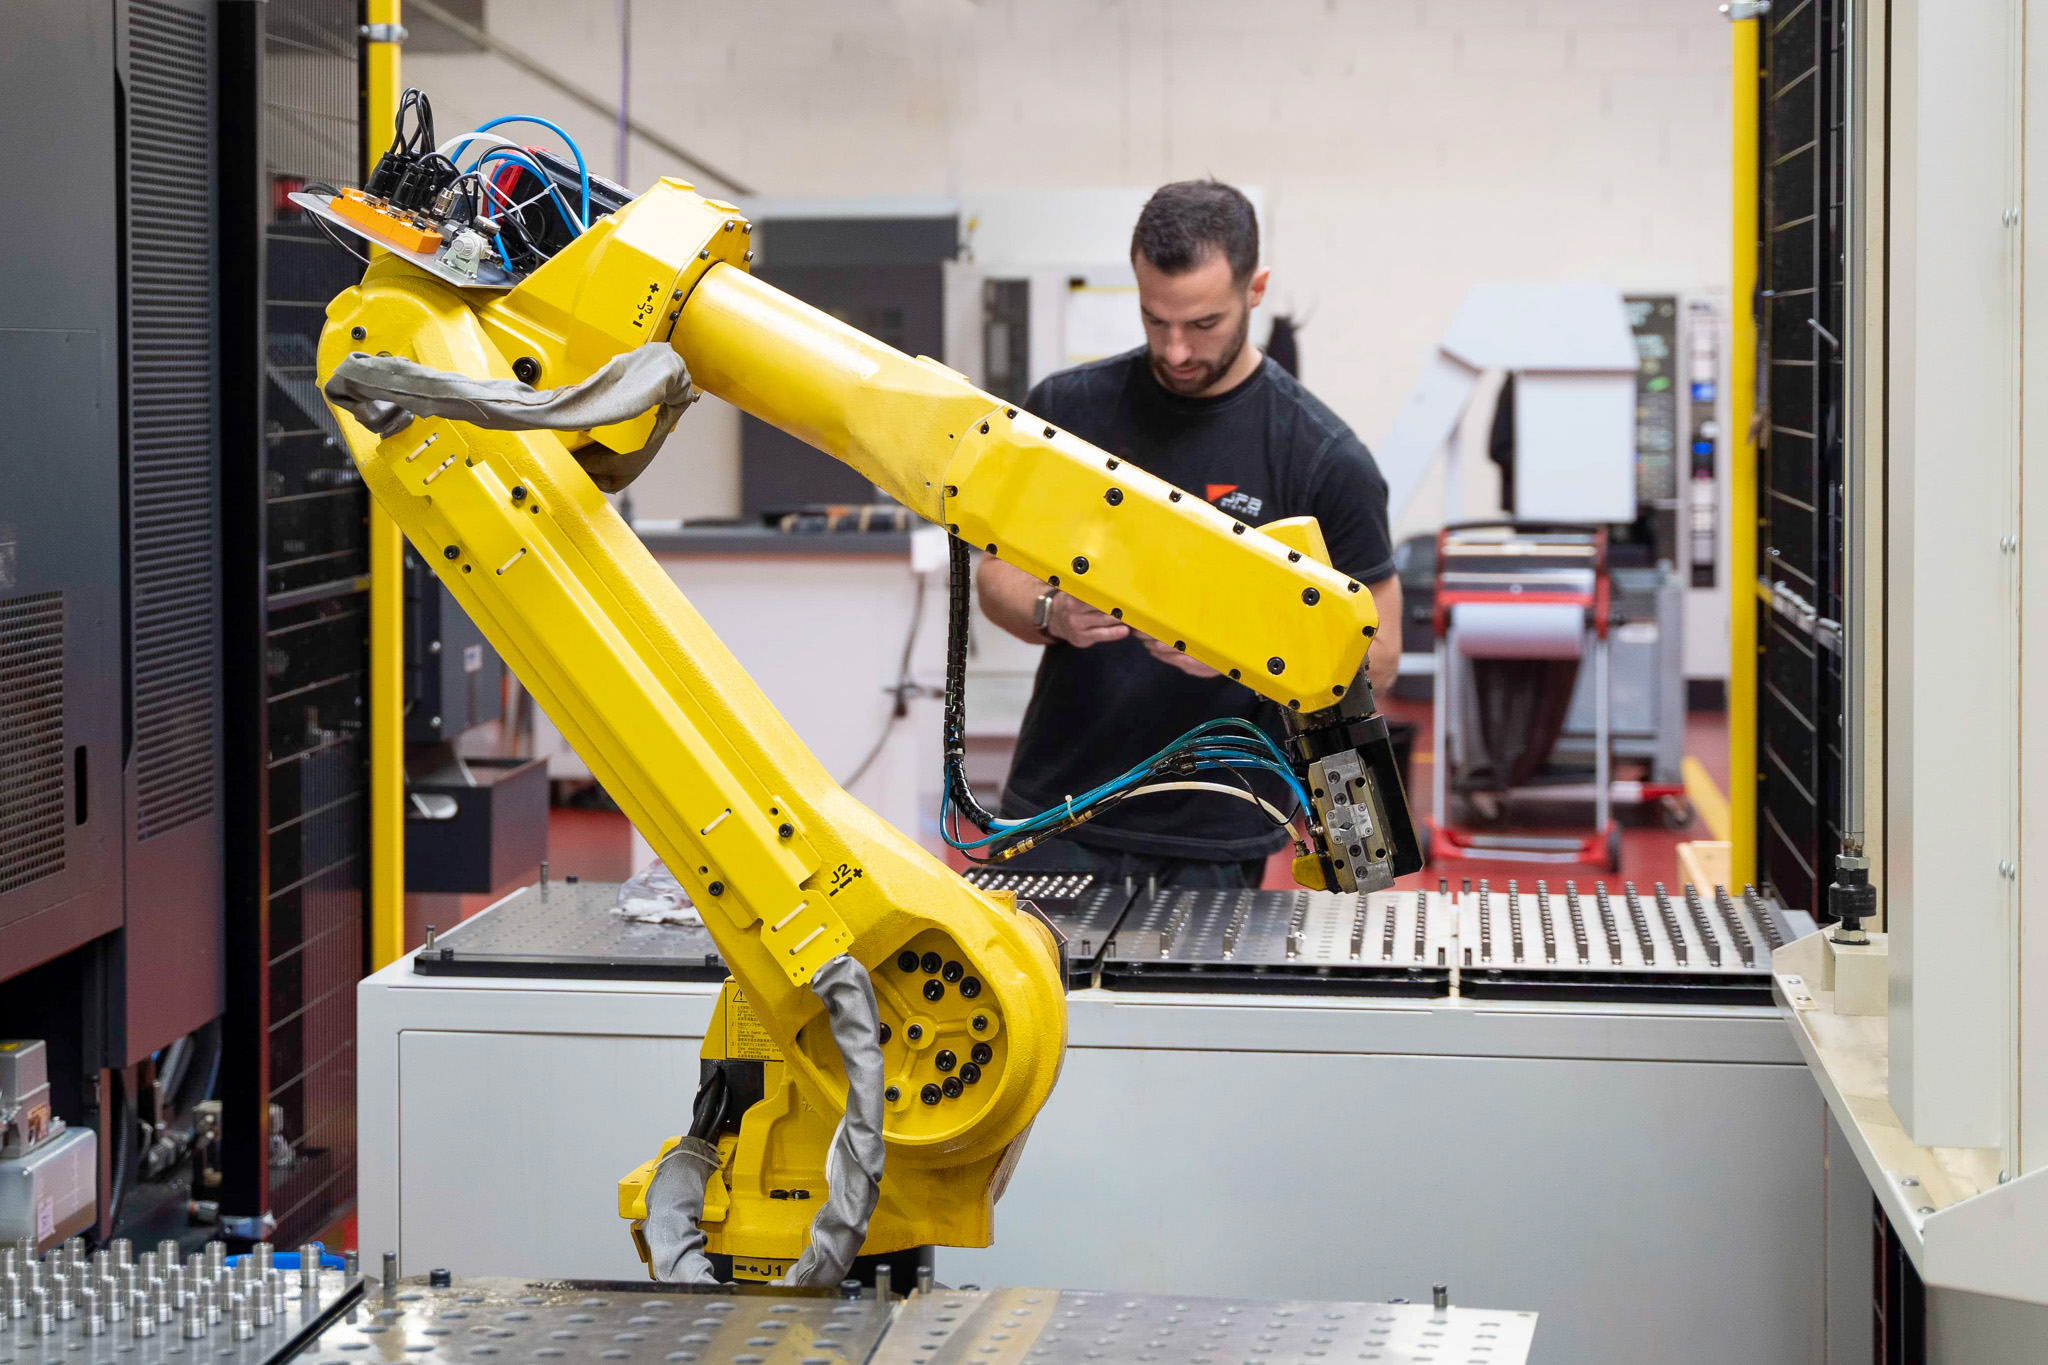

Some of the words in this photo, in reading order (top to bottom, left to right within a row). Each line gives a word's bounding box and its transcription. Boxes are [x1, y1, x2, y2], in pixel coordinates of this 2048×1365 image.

[637, 302, 654, 314] J3
[830, 863, 851, 884] J2
[760, 1264, 782, 1276] J1
